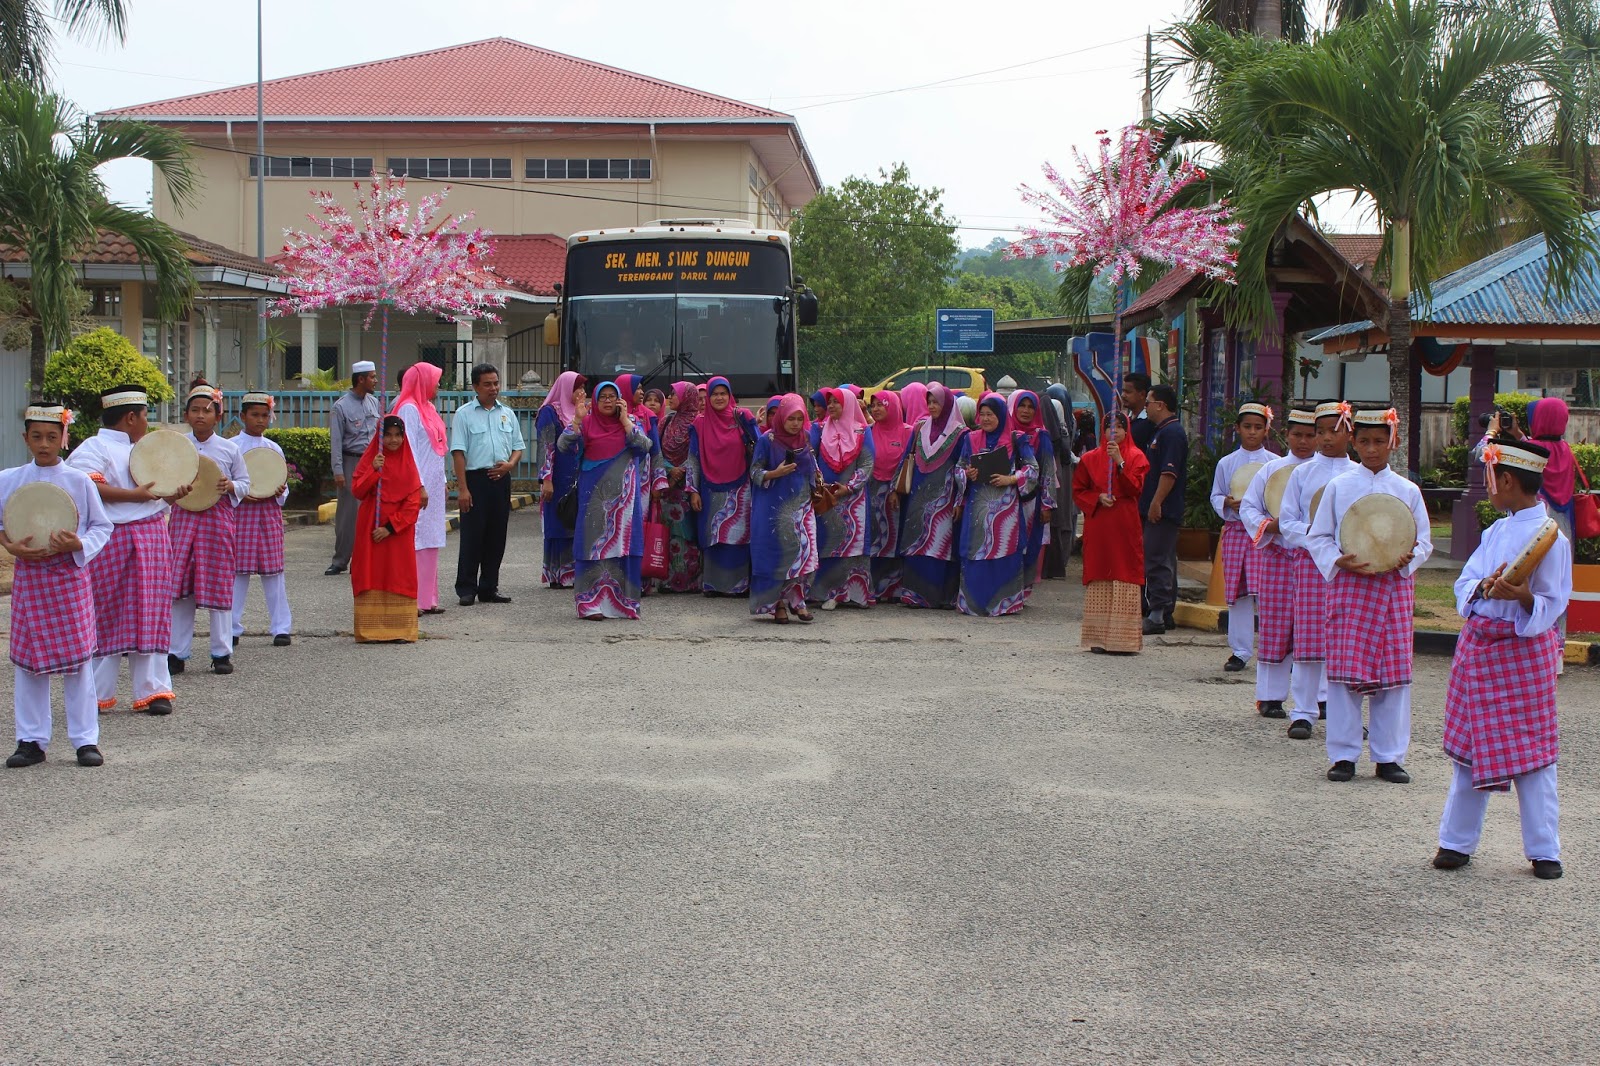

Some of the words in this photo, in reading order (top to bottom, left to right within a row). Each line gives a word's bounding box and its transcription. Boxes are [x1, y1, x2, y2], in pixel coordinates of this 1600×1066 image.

[605, 253, 628, 269] SEK.
[635, 252, 662, 267] MEN.
[706, 251, 750, 267] DUNGUN
[618, 272, 674, 282] TERENGGANU
[680, 271, 708, 281] DARUL
[713, 272, 737, 281] IMAN
